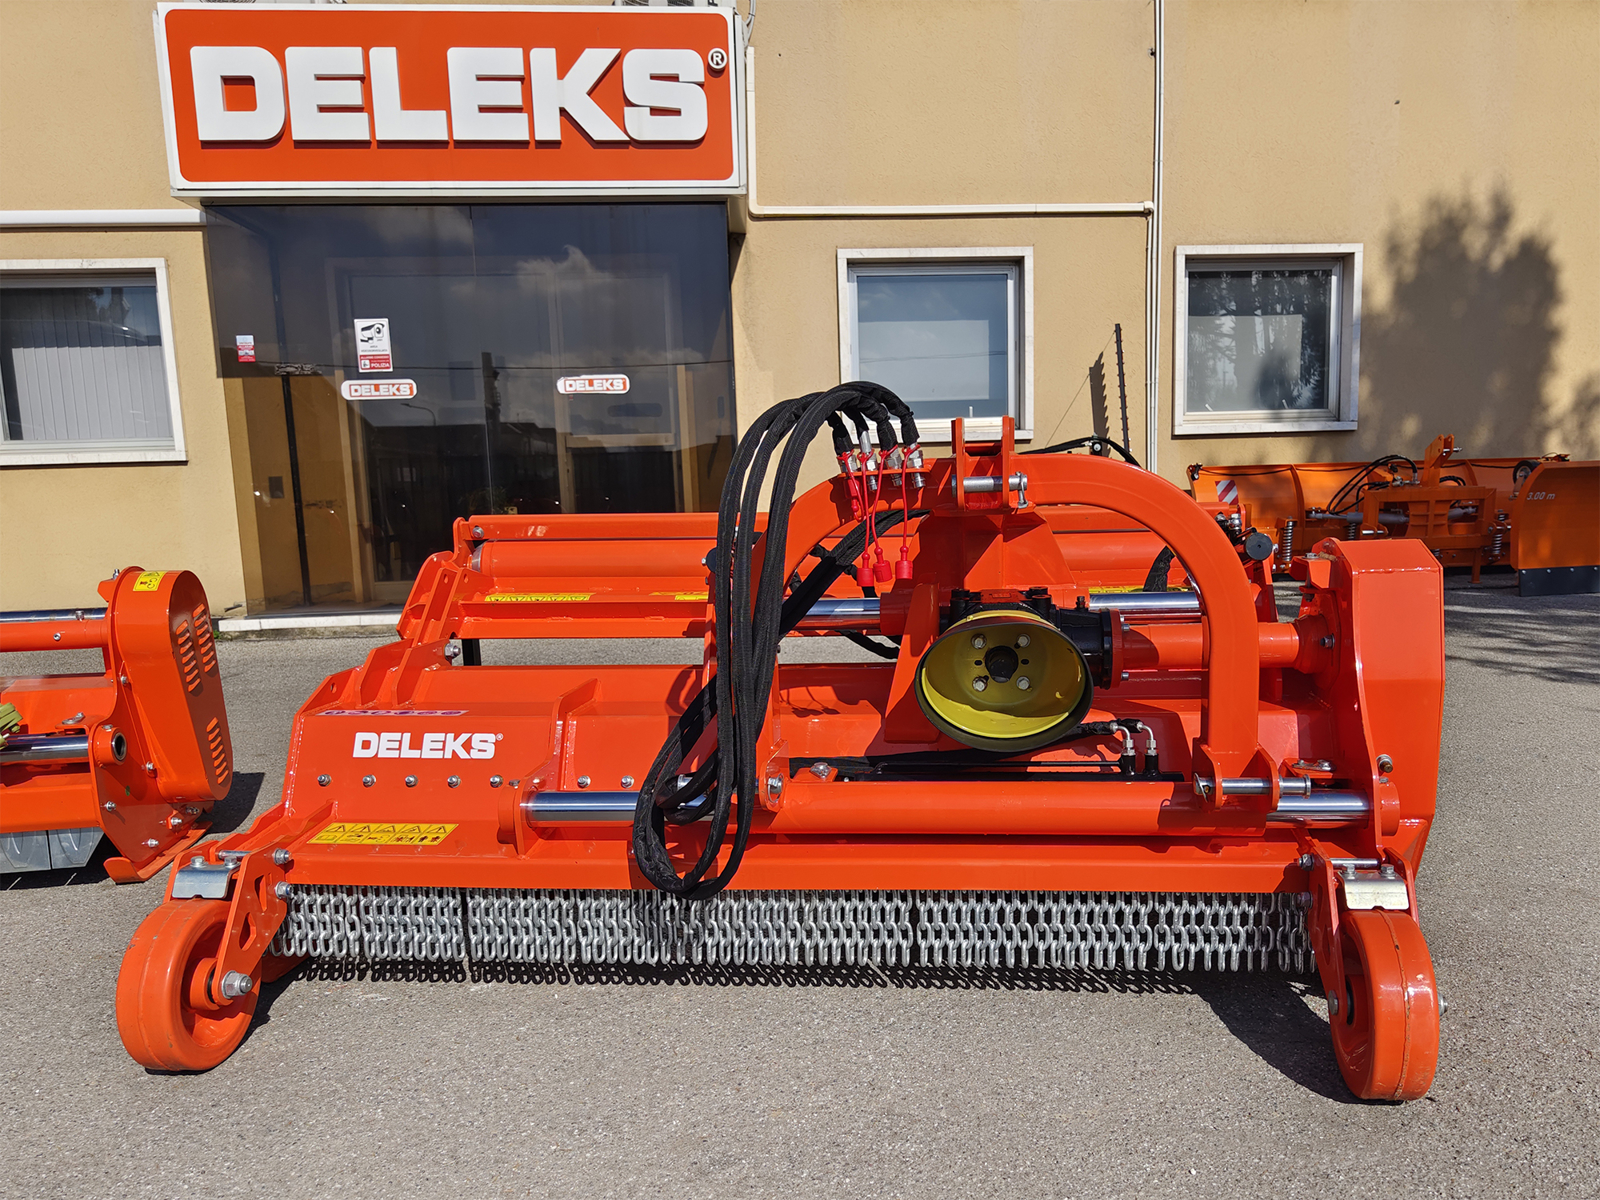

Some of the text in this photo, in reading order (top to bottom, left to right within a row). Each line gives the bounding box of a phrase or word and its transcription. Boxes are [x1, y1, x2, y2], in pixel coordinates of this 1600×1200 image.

[190, 46, 709, 142] DELEKS
[350, 384, 410, 396] DELEKS
[565, 379, 623, 391] DELEKS
[1527, 492, 1546, 500] 3.00
[352, 732, 496, 759] DELEKS
